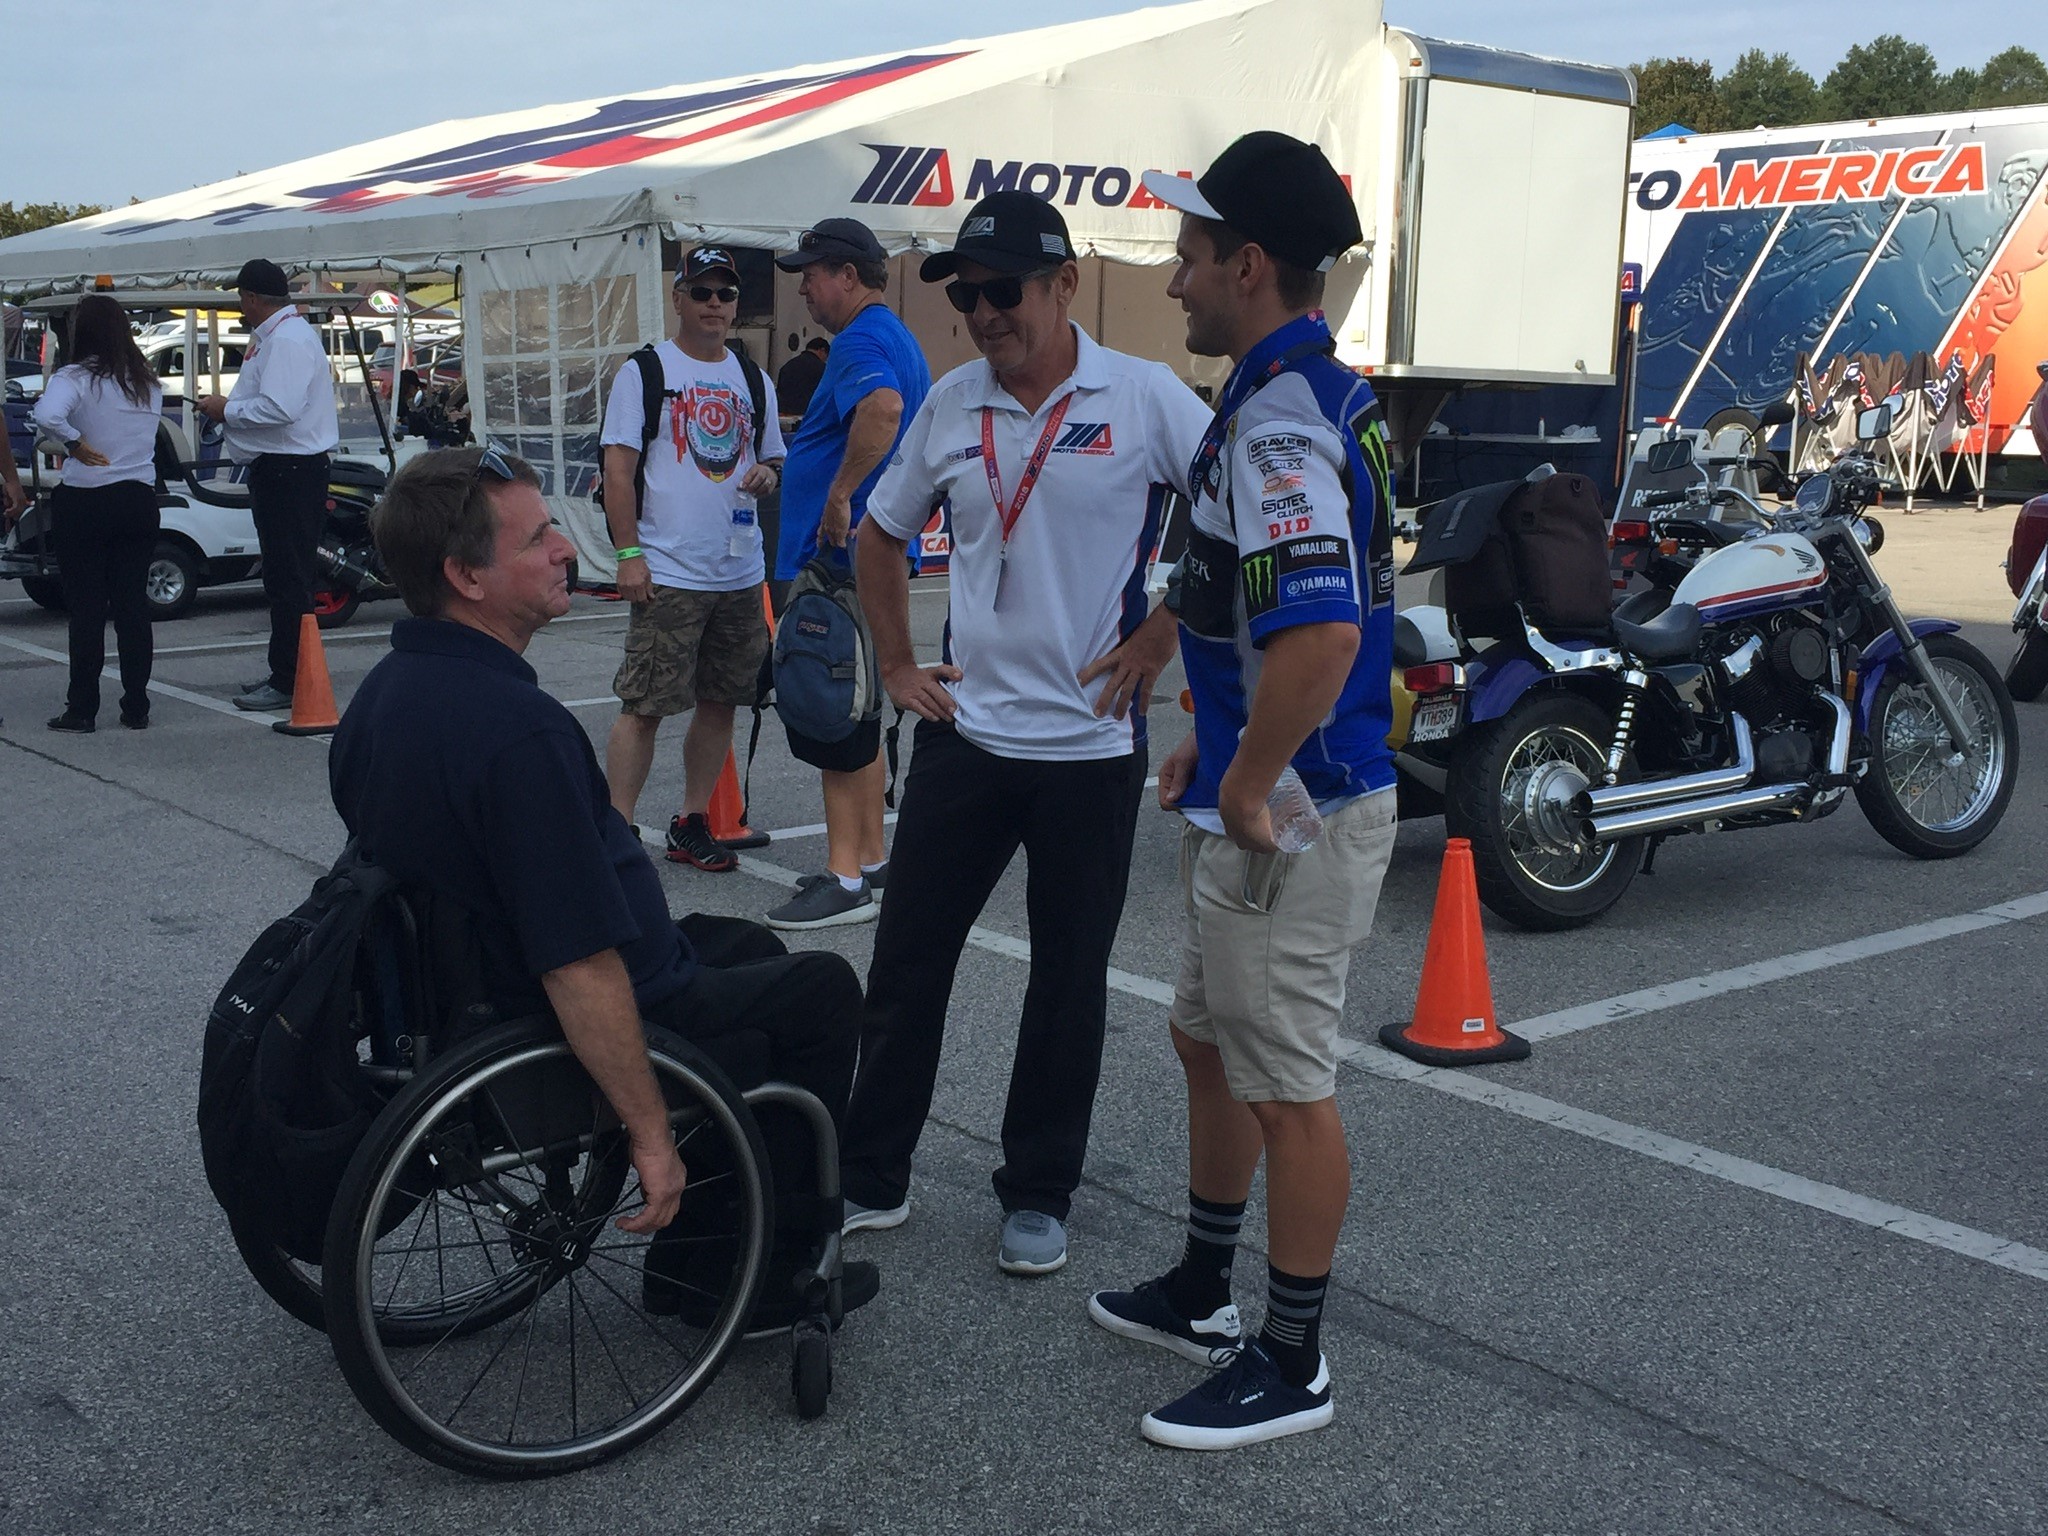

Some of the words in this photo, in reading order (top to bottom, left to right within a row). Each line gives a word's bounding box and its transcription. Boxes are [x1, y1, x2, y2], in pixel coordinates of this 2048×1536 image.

[1629, 145, 1986, 210] OAMERICA
[1250, 437, 1307, 453] GRAVES
[1262, 493, 1307, 515] SUTER
[1277, 505, 1313, 518] CLUTCH
[1289, 541, 1340, 558] YAMALUBE
[1300, 576, 1347, 592] YAMAHA
[1413, 730, 1449, 743] HONDA
